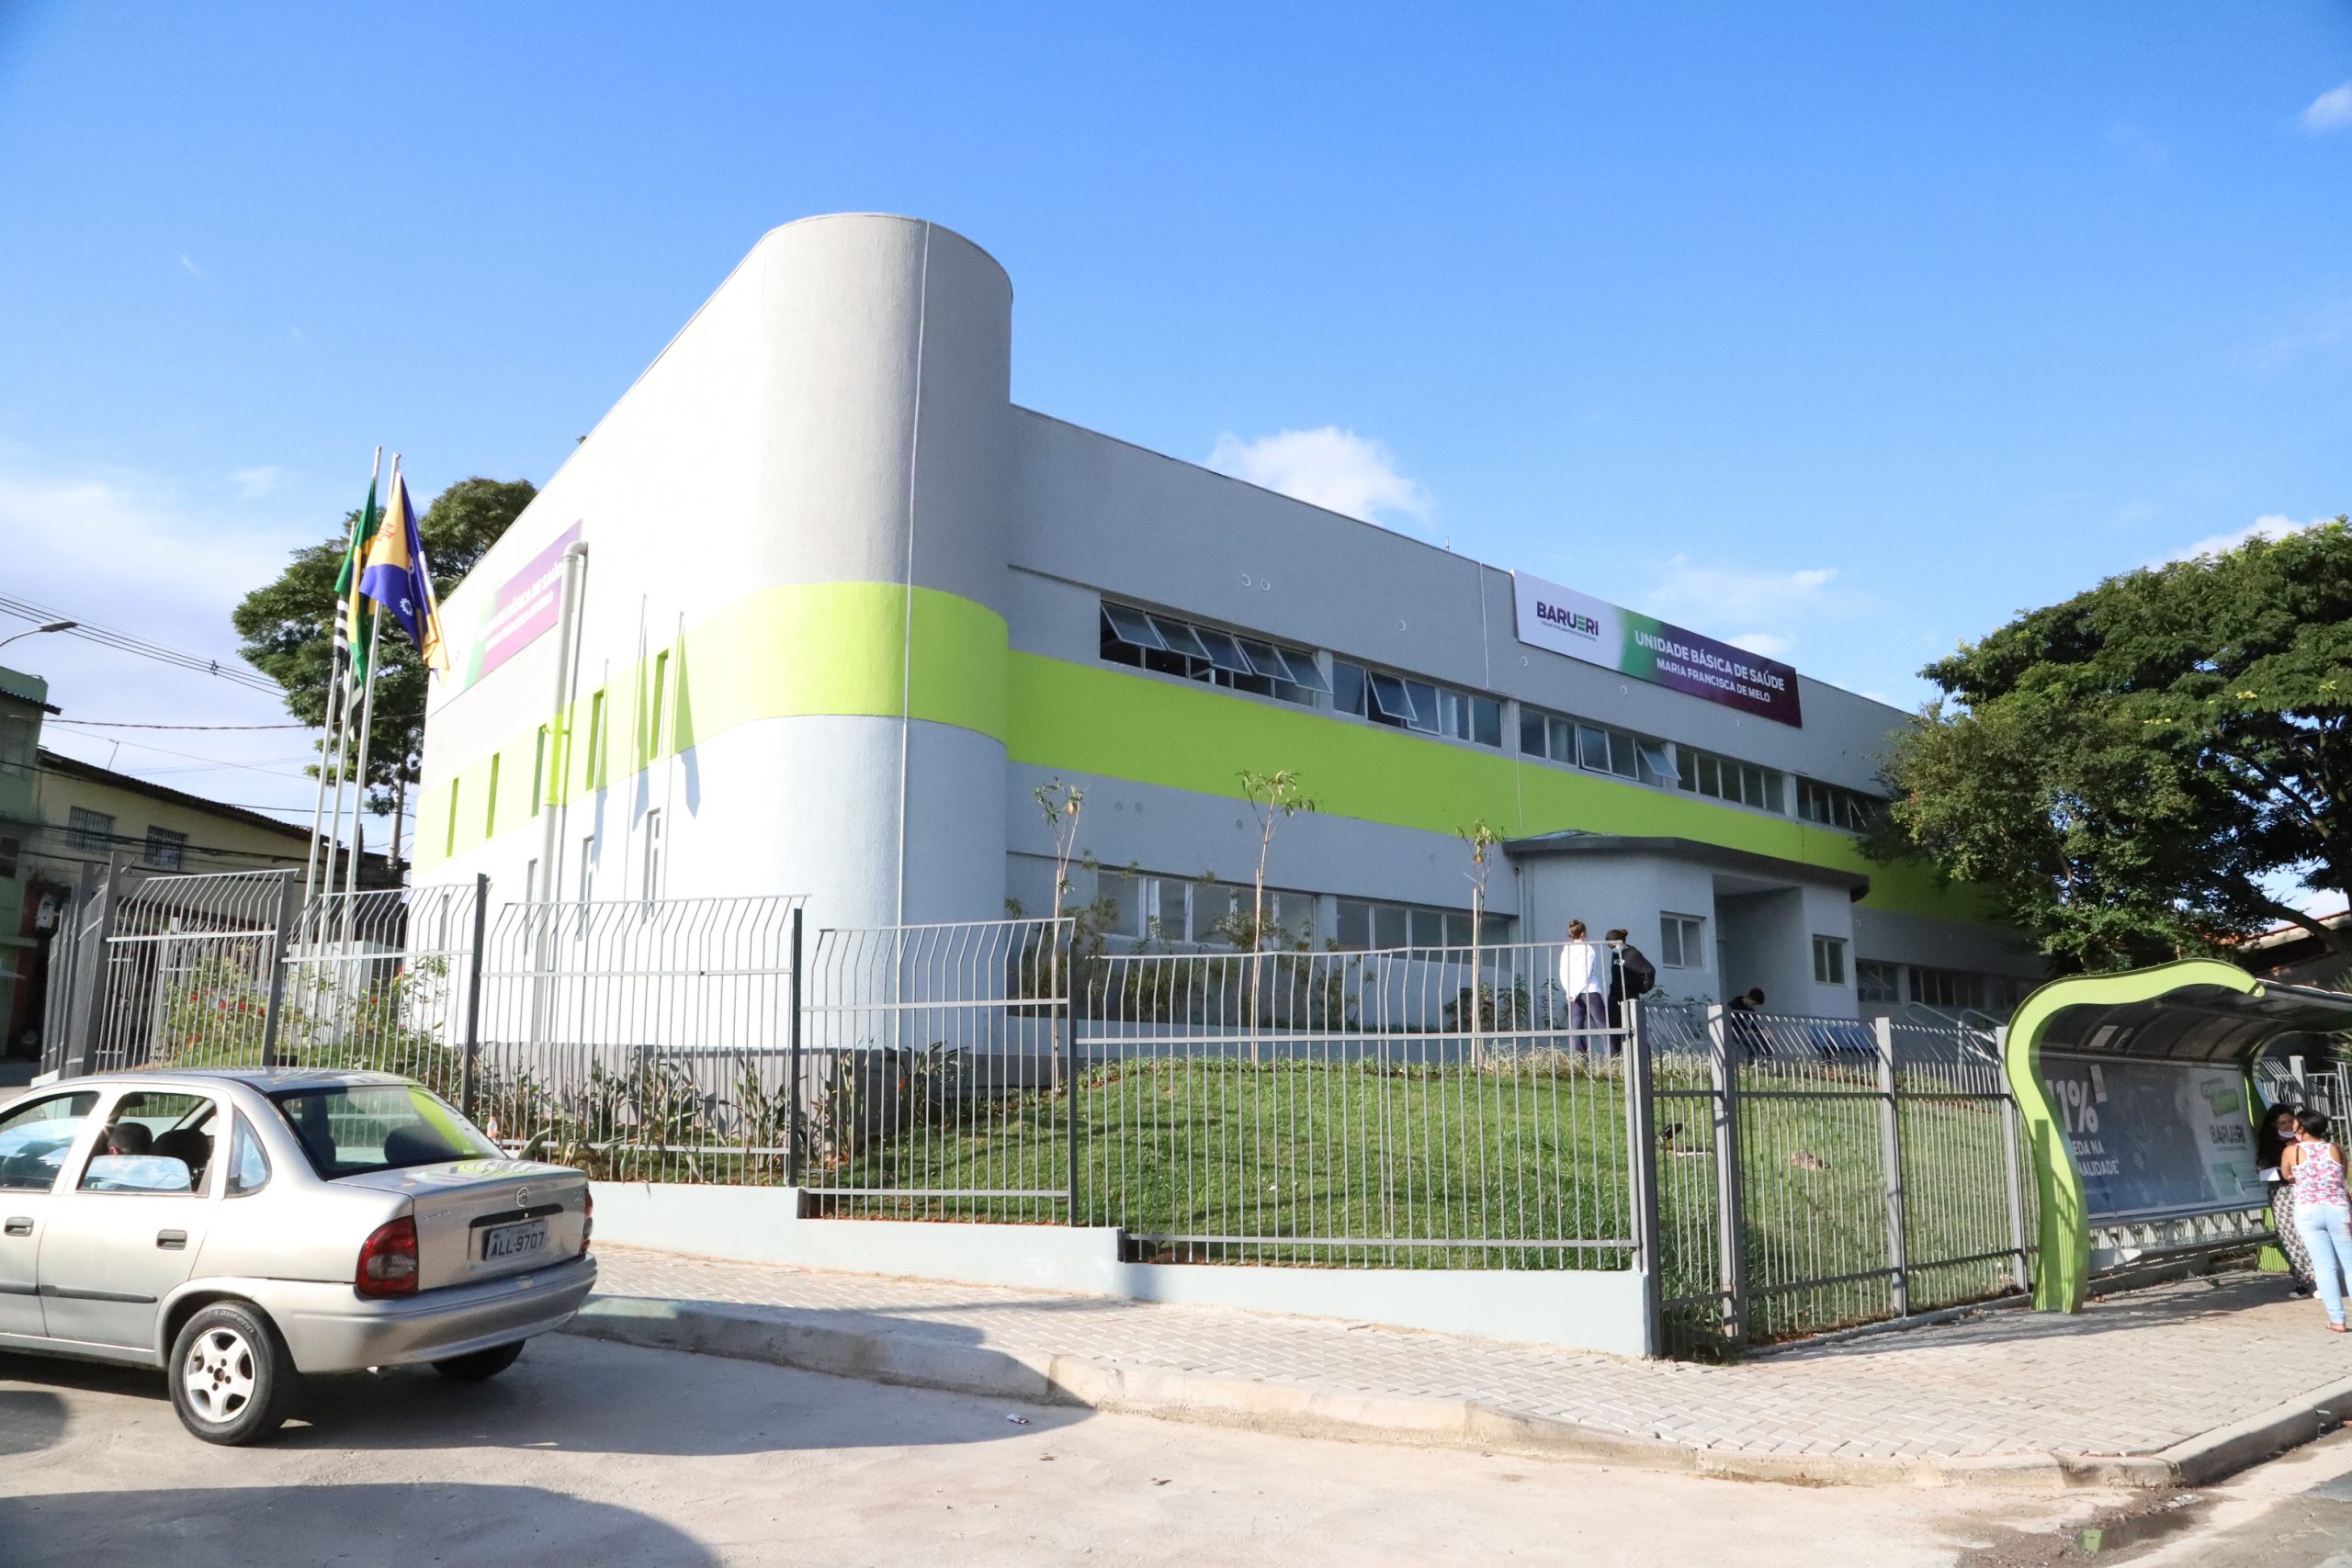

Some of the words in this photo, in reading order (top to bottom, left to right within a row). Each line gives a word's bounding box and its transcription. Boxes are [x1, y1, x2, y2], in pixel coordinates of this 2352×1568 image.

[1537, 601, 1599, 636] BARUERI
[1635, 629, 1690, 660] UNIDADE
[1690, 649, 1733, 675] BÁSICA
[1734, 663, 1748, 680] DE
[1749, 669, 1785, 691] SAÚDE
[1657, 657, 1687, 677] MARIA
[1687, 667, 1736, 693] FRANCISCA
[1736, 683, 1747, 696] DE
[1747, 687, 1770, 703] MELO
[2090, 1140, 2105, 1155] NA
[2209, 1123, 2247, 1144] BARUERI
